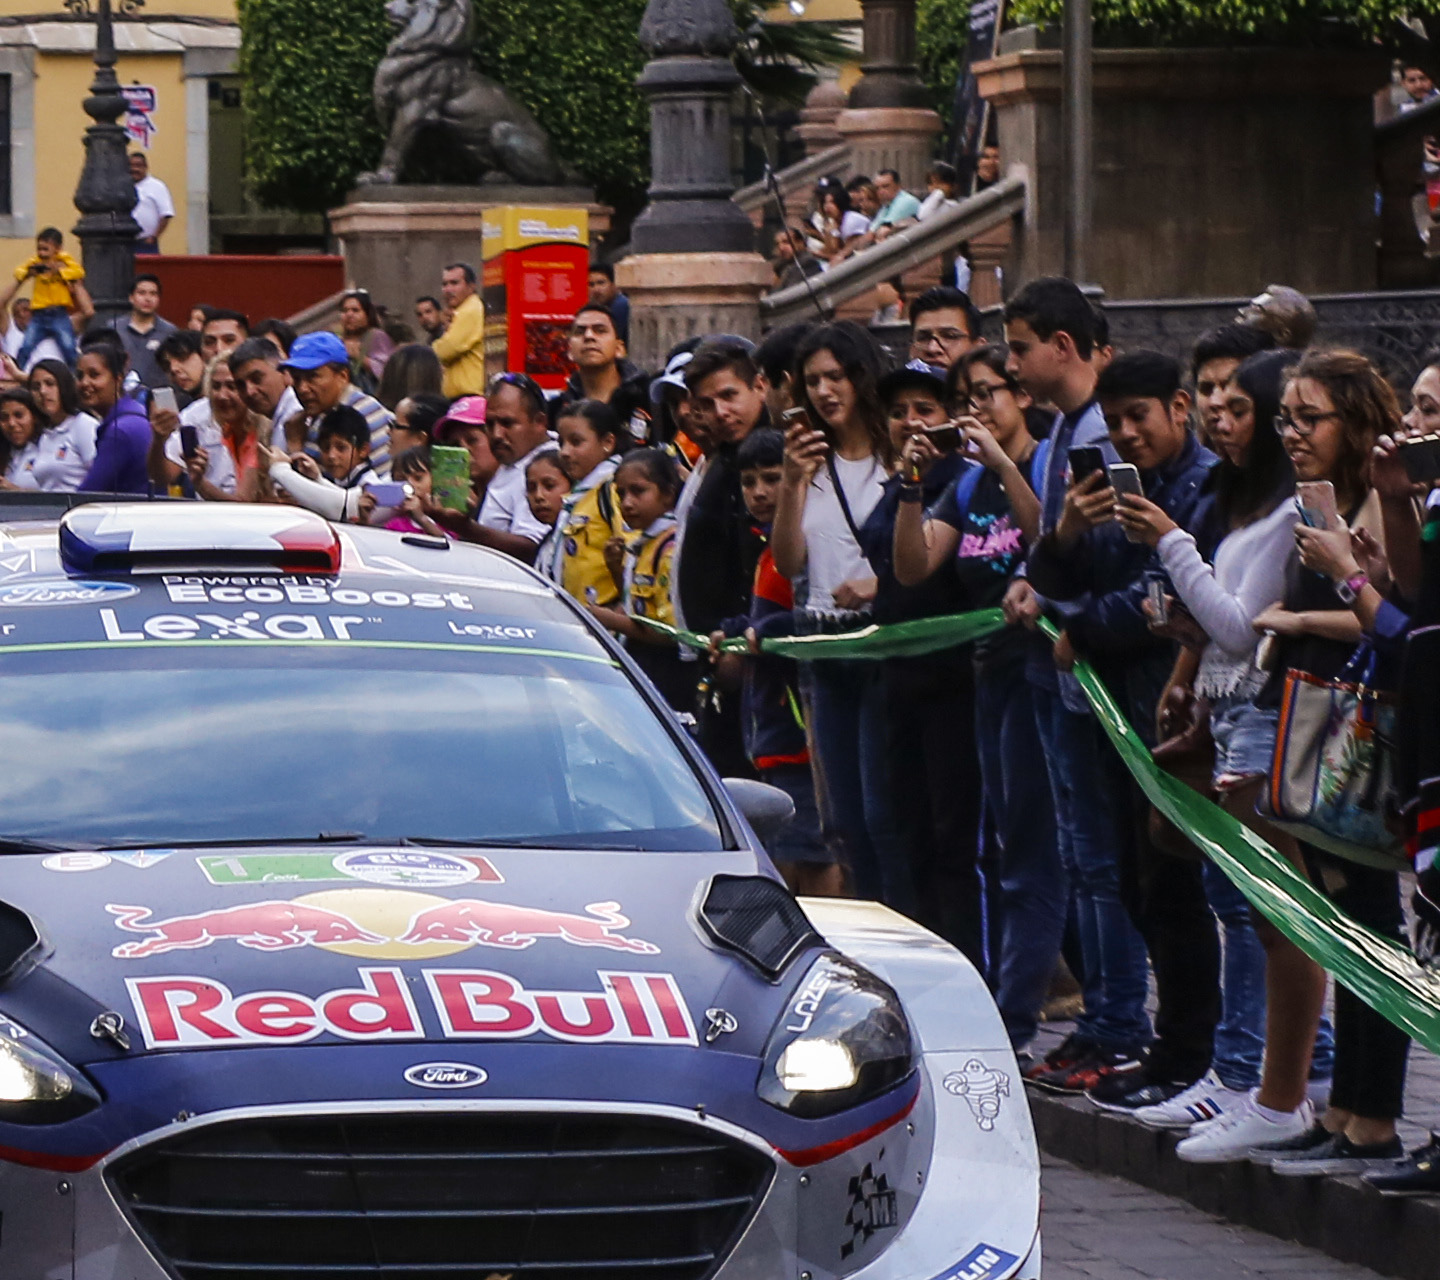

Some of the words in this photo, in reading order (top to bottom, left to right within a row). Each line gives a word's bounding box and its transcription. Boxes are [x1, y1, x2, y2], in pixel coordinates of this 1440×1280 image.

[162, 575, 297, 586] Powered
[303, 575, 342, 588] by
[0, 583, 108, 604] Ford
[168, 585, 473, 611] EcoBoost
[99, 608, 364, 640] Lexar
[447, 620, 537, 641] Lexar
[126, 968, 424, 1048] Red
[424, 970, 698, 1046] Bull
[423, 1066, 469, 1084] Ford
